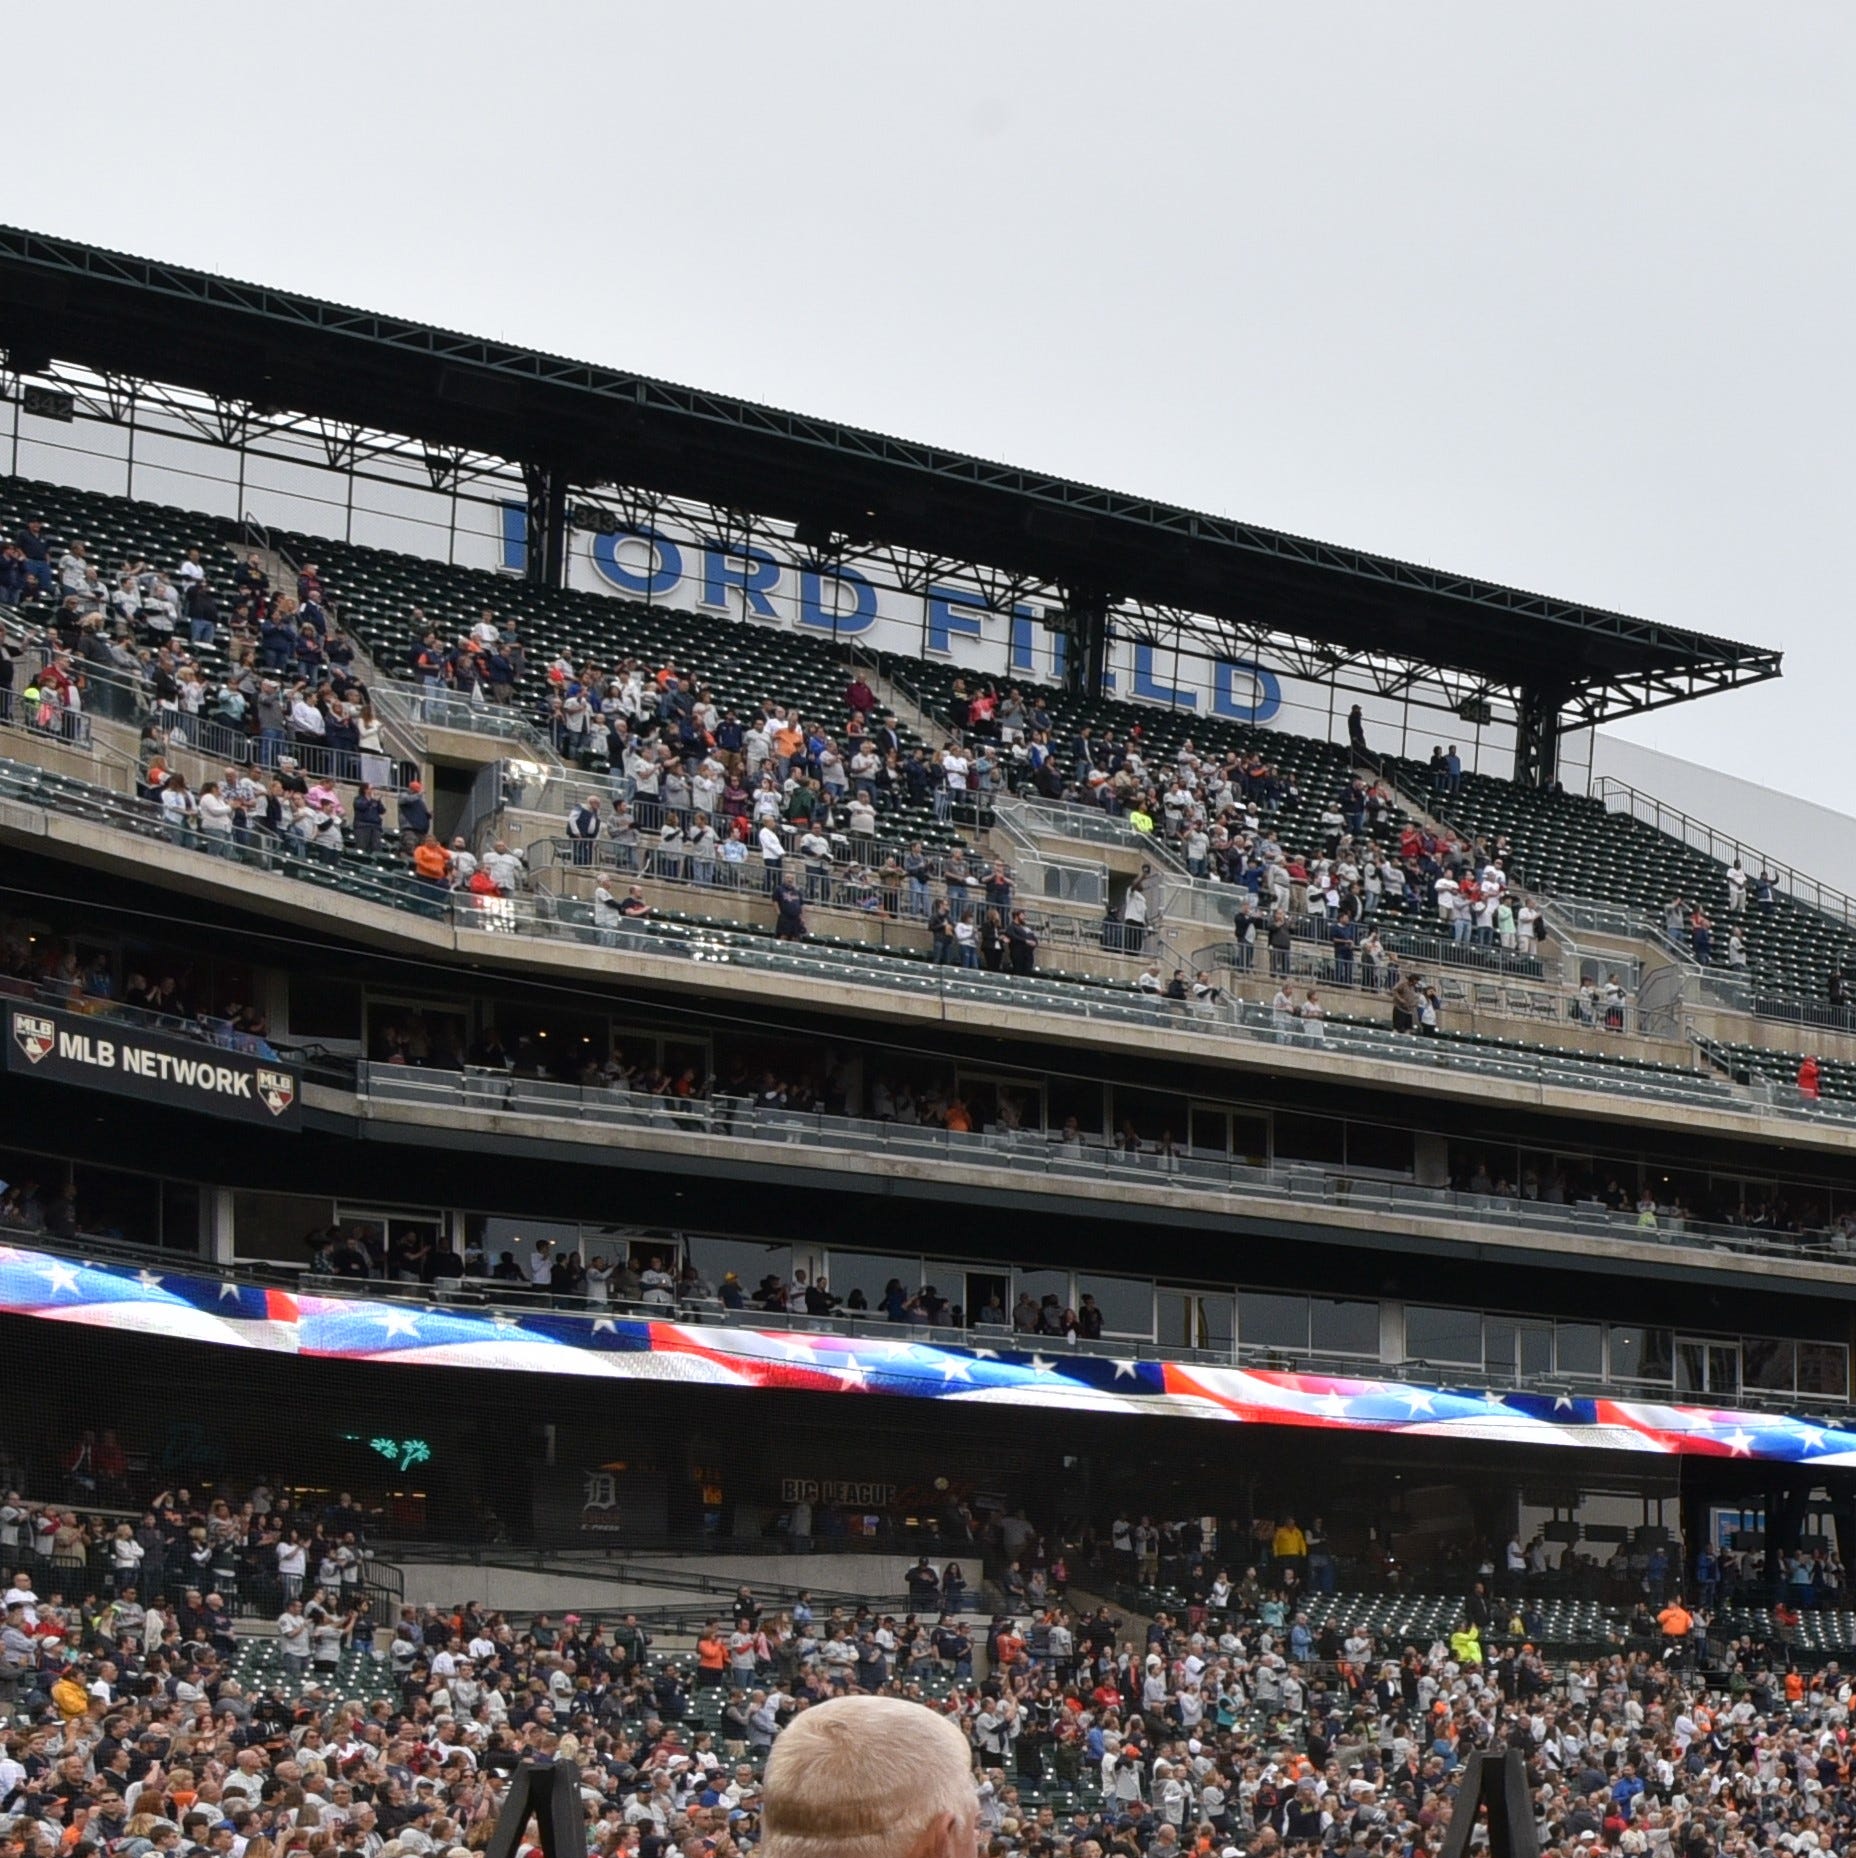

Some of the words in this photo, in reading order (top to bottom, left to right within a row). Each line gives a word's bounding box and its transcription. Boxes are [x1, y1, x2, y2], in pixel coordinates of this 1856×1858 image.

[924, 584, 1283, 726] FILD
[59, 1032, 115, 1068] MLB
[123, 1046, 251, 1098] NETWORK
[259, 1072, 291, 1089] MLB
[782, 1479, 817, 1502] BIG
[823, 1480, 896, 1505] LEAGUE
